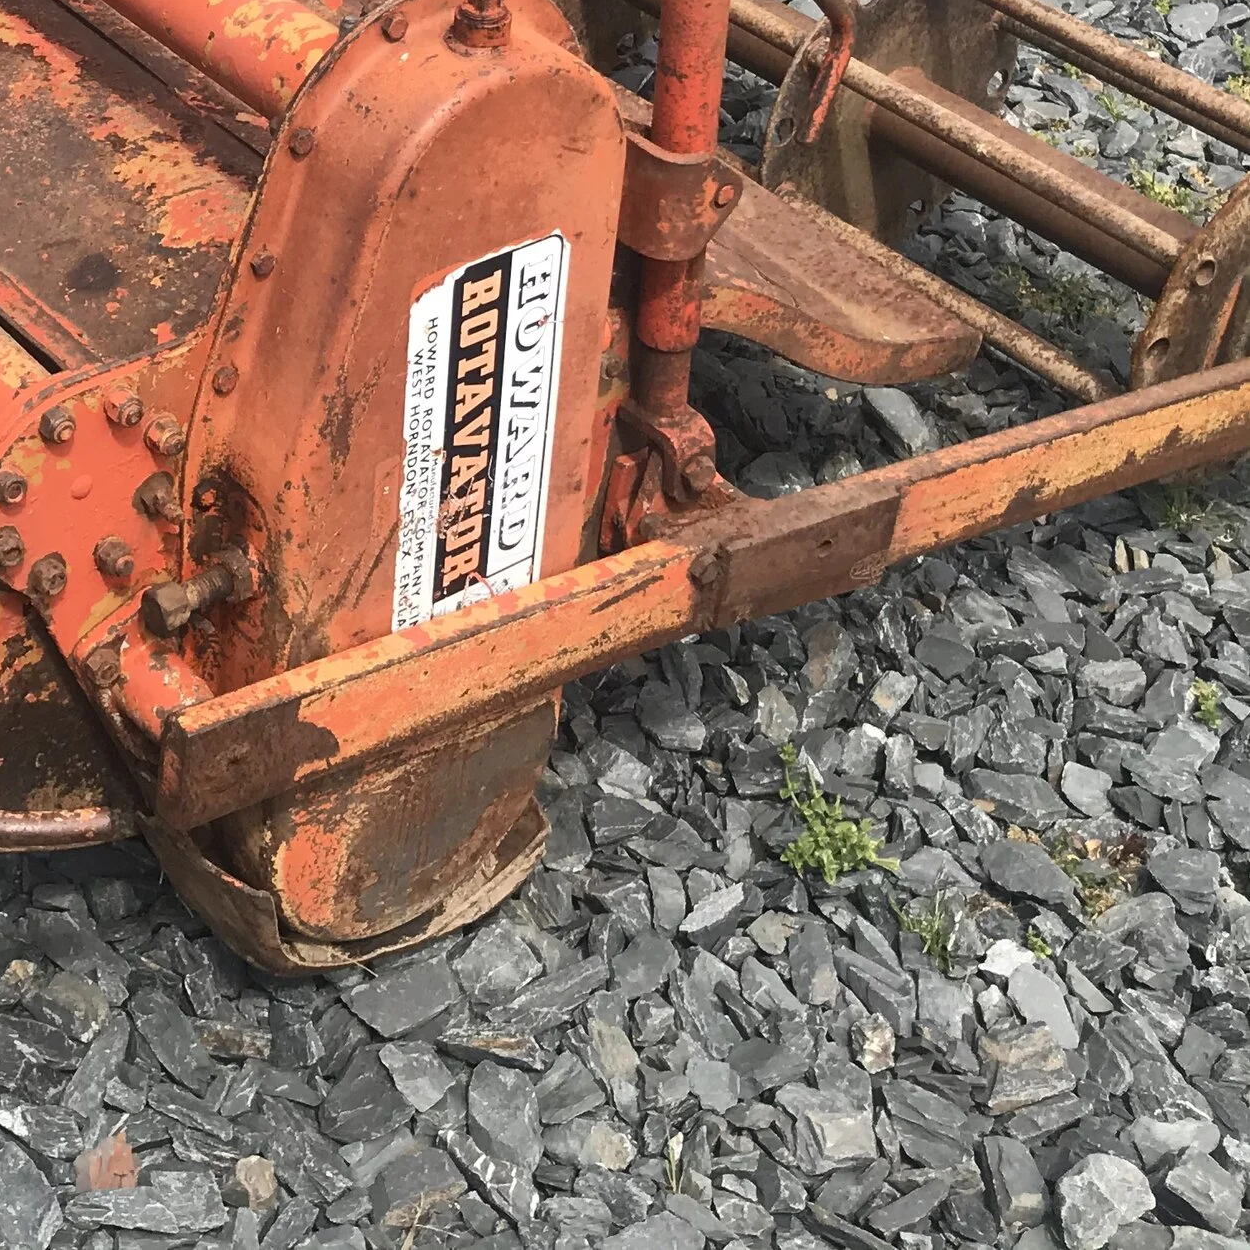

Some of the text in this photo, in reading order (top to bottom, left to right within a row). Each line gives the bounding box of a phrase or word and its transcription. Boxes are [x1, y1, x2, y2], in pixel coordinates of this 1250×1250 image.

[411, 348, 424, 398] WEST
[424, 316, 439, 399] HOWARD
[499, 254, 554, 551] HOWARD
[405, 404, 421, 495] HORNDON
[417, 407, 433, 511] ROTAVATOR
[442, 269, 502, 586] ROTAVATOR
